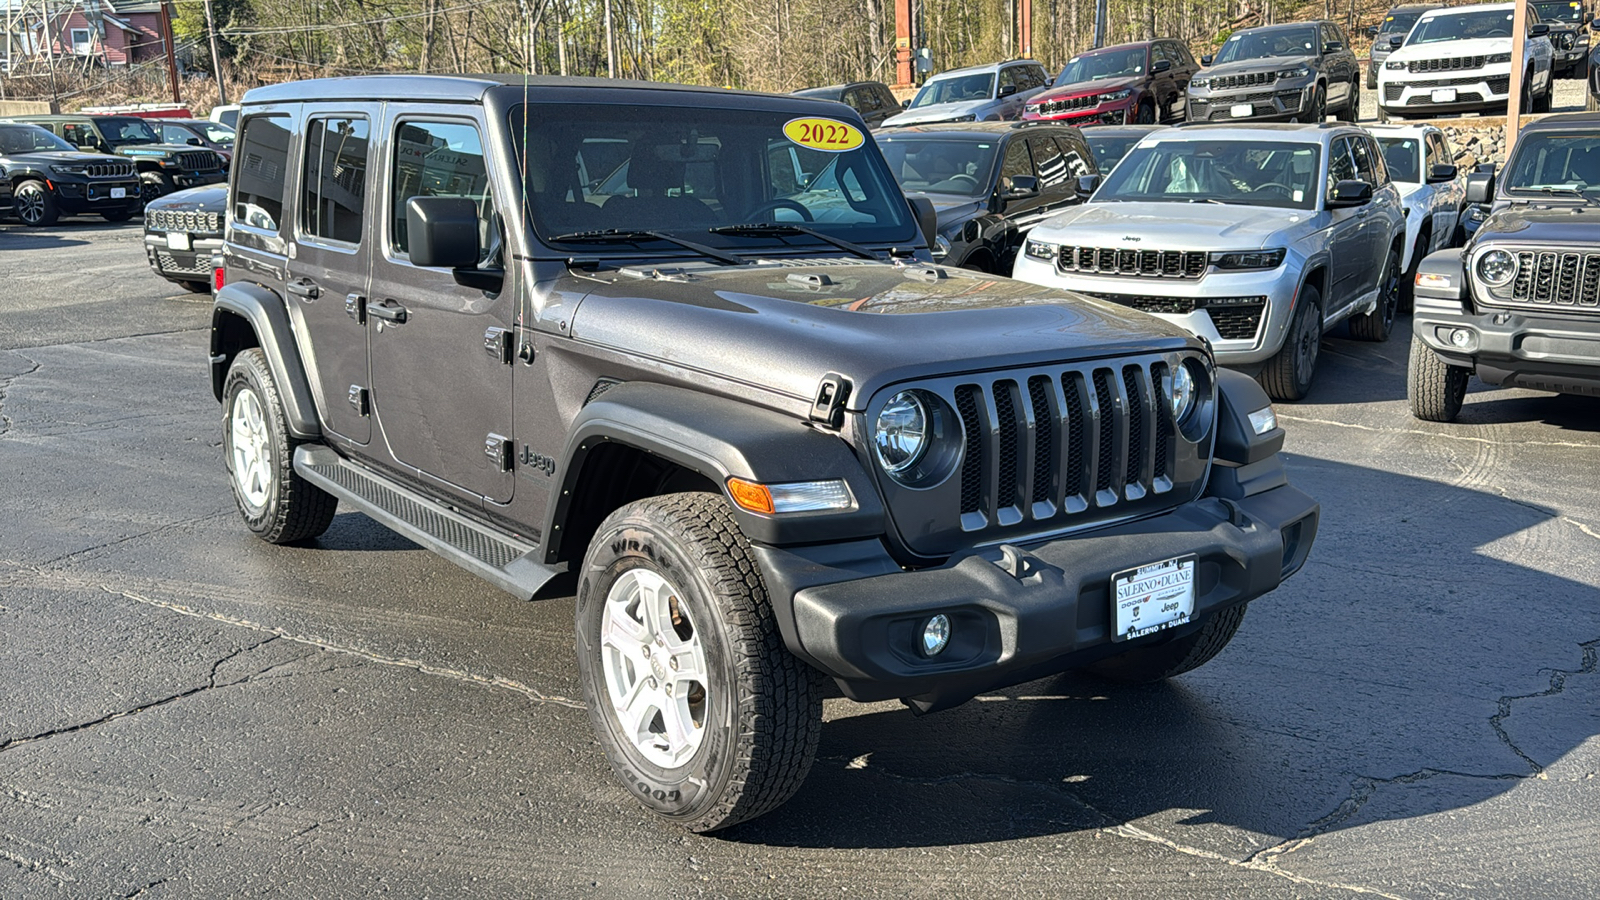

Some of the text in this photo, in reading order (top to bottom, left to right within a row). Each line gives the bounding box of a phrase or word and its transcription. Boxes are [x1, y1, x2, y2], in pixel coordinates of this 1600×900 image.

[799, 123, 849, 144] 2022
[1122, 235, 1141, 243] Jeep
[519, 443, 555, 477] Jeep
[1117, 579, 1157, 600] SALERNO
[1161, 570, 1191, 587] DUANE
[1161, 602, 1179, 613] Jeep
[1126, 616, 1191, 640] SALERNO DUANE
